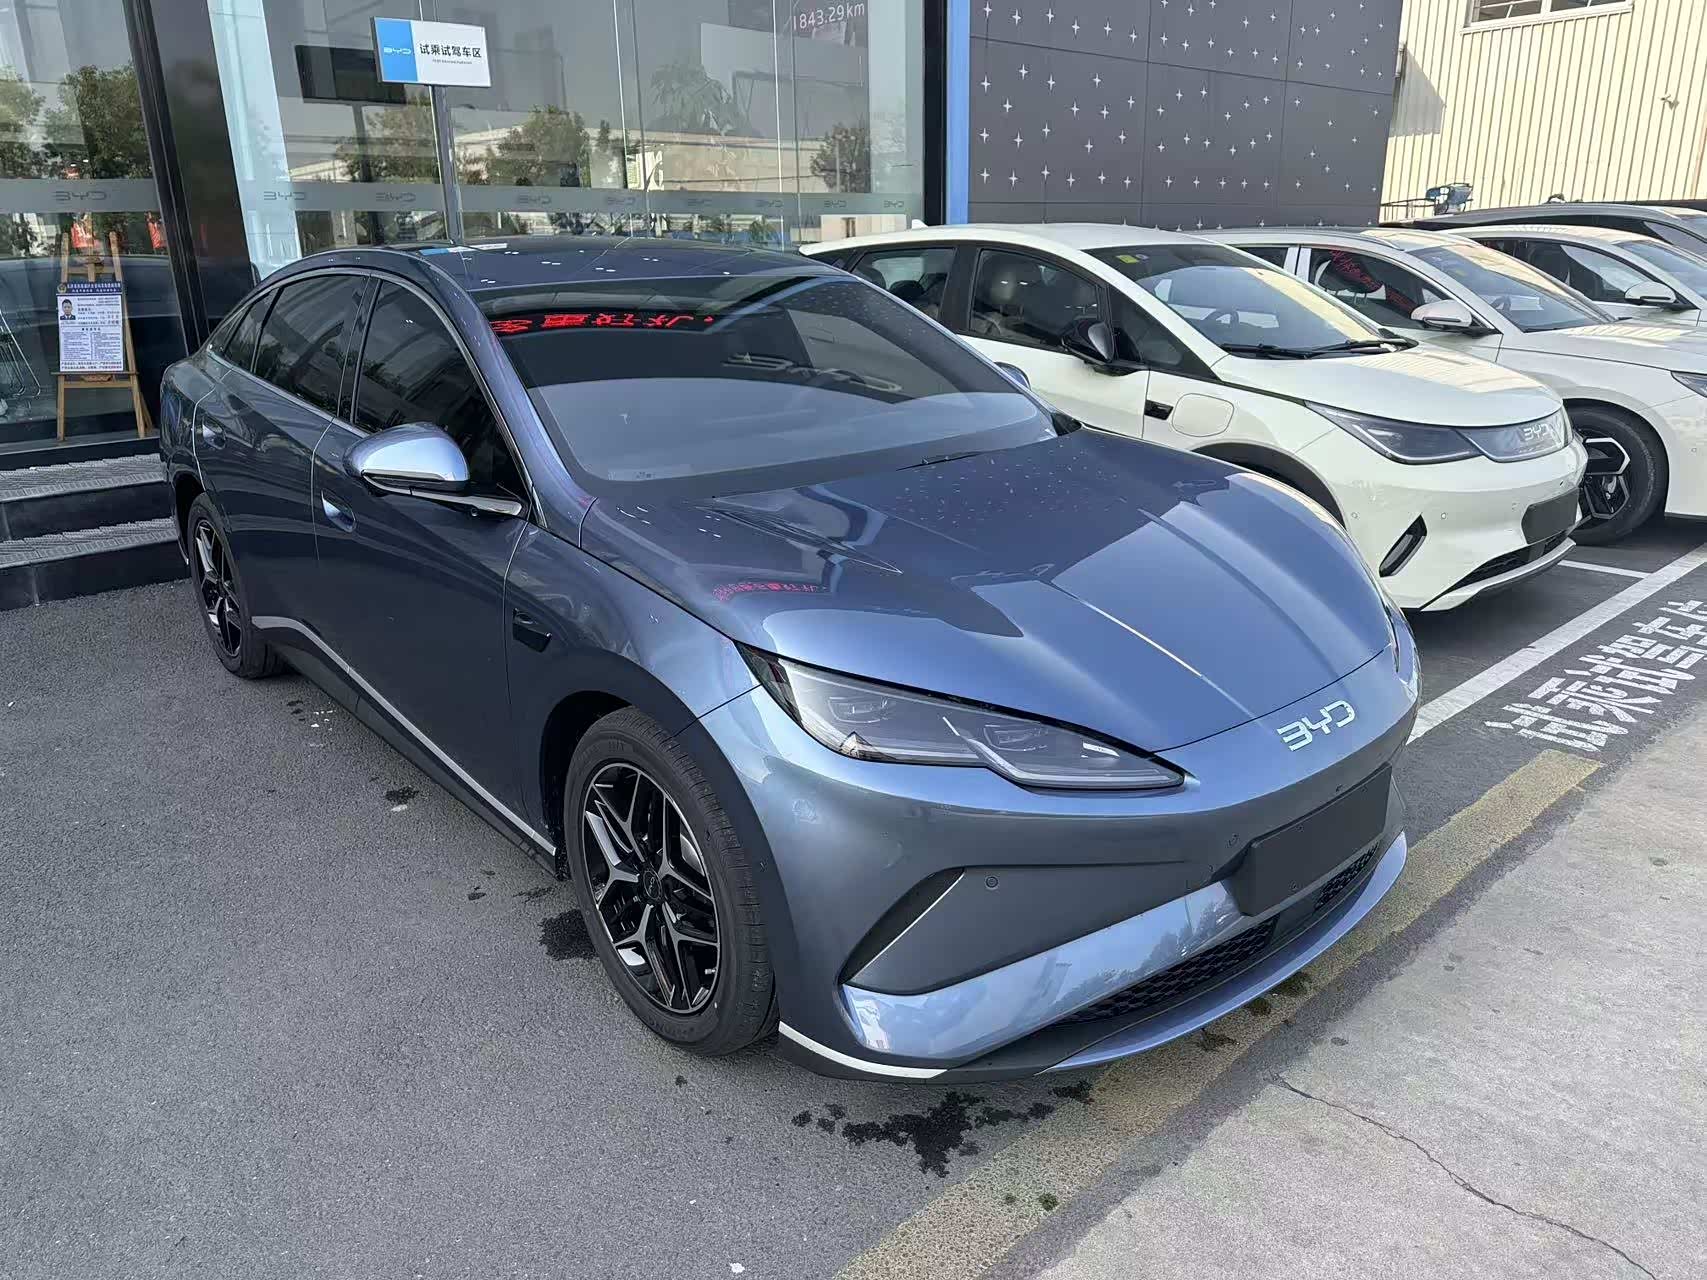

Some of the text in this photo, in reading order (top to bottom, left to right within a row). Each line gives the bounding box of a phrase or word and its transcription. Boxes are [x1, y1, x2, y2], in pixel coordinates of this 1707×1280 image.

[383, 46, 412, 55] BYD
[419, 43, 482, 58] 试乘试驾车区
[52, 190, 107, 201] BYD
[263, 191, 306, 201] BYD
[1523, 423, 1550, 441] BYD
[1276, 700, 1356, 752] BYD
